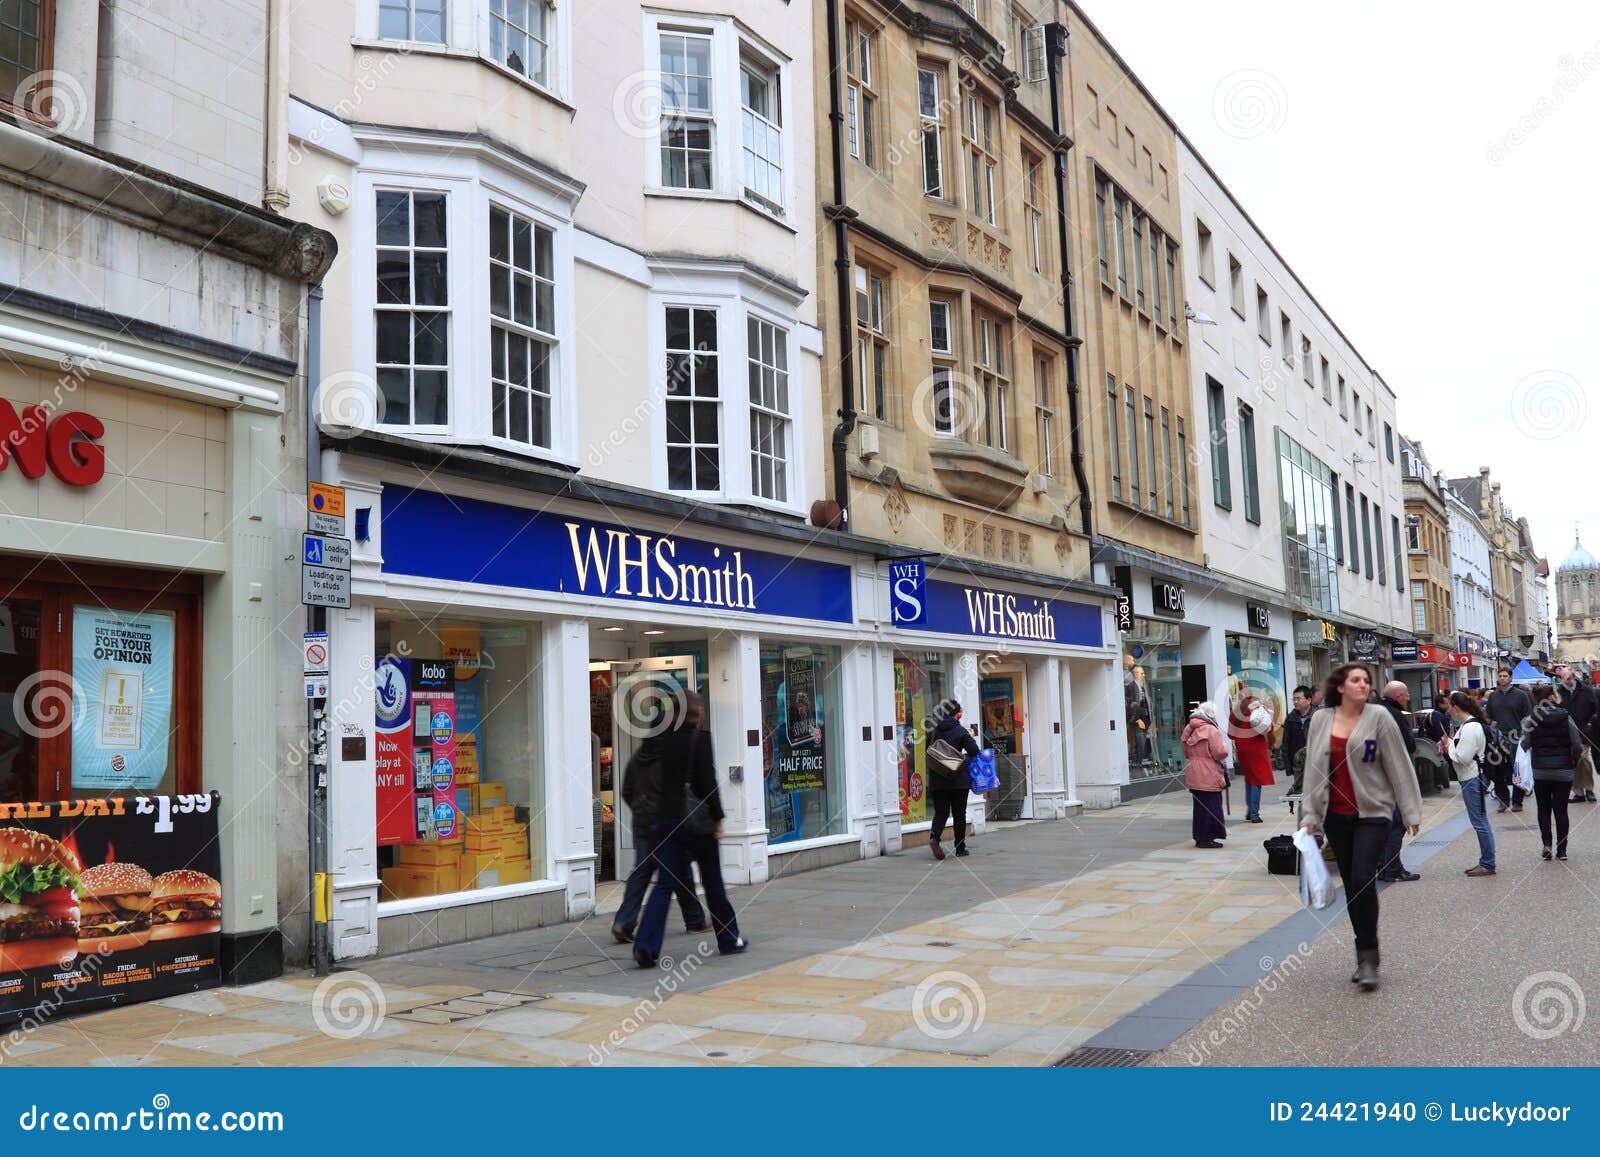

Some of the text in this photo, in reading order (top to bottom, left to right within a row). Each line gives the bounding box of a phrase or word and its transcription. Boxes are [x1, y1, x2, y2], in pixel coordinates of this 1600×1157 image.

[324, 543, 349, 556] Loading
[329, 555, 344, 564] only
[565, 522, 757, 610] WHSmith
[309, 569, 334, 581] Loading
[893, 564, 920, 579] WH
[313, 580, 341, 591] to studs
[312, 594, 324, 603] pm
[328, 595, 336, 603] 10
[894, 577, 923, 622] S
[1163, 583, 1187, 613] next
[964, 588, 1057, 641] WHSmith
[1119, 595, 1131, 629] next
[1255, 607, 1273, 629] next
[95, 627, 152, 641] GET REWARDED
[95, 635, 151, 652] FOR YOUR
[93, 647, 152, 665] OPINION
[422, 663, 446, 679] kobo
[108, 705, 133, 716] FREE
[378, 741, 398, 752] Now
[1361, 739, 1377, 763] R
[393, 758, 401, 768] at
[779, 756, 823, 772] HALF PRICE
[394, 774, 405, 786] till
[59, 798, 125, 817] DAY
[174, 954, 199, 963] SATURDAY
[117, 963, 137, 971] FRIDAY
[126, 968, 150, 976] DOUBLE
[161, 963, 188, 972] CHICKEN
[102, 978, 127, 986] CHEESE
